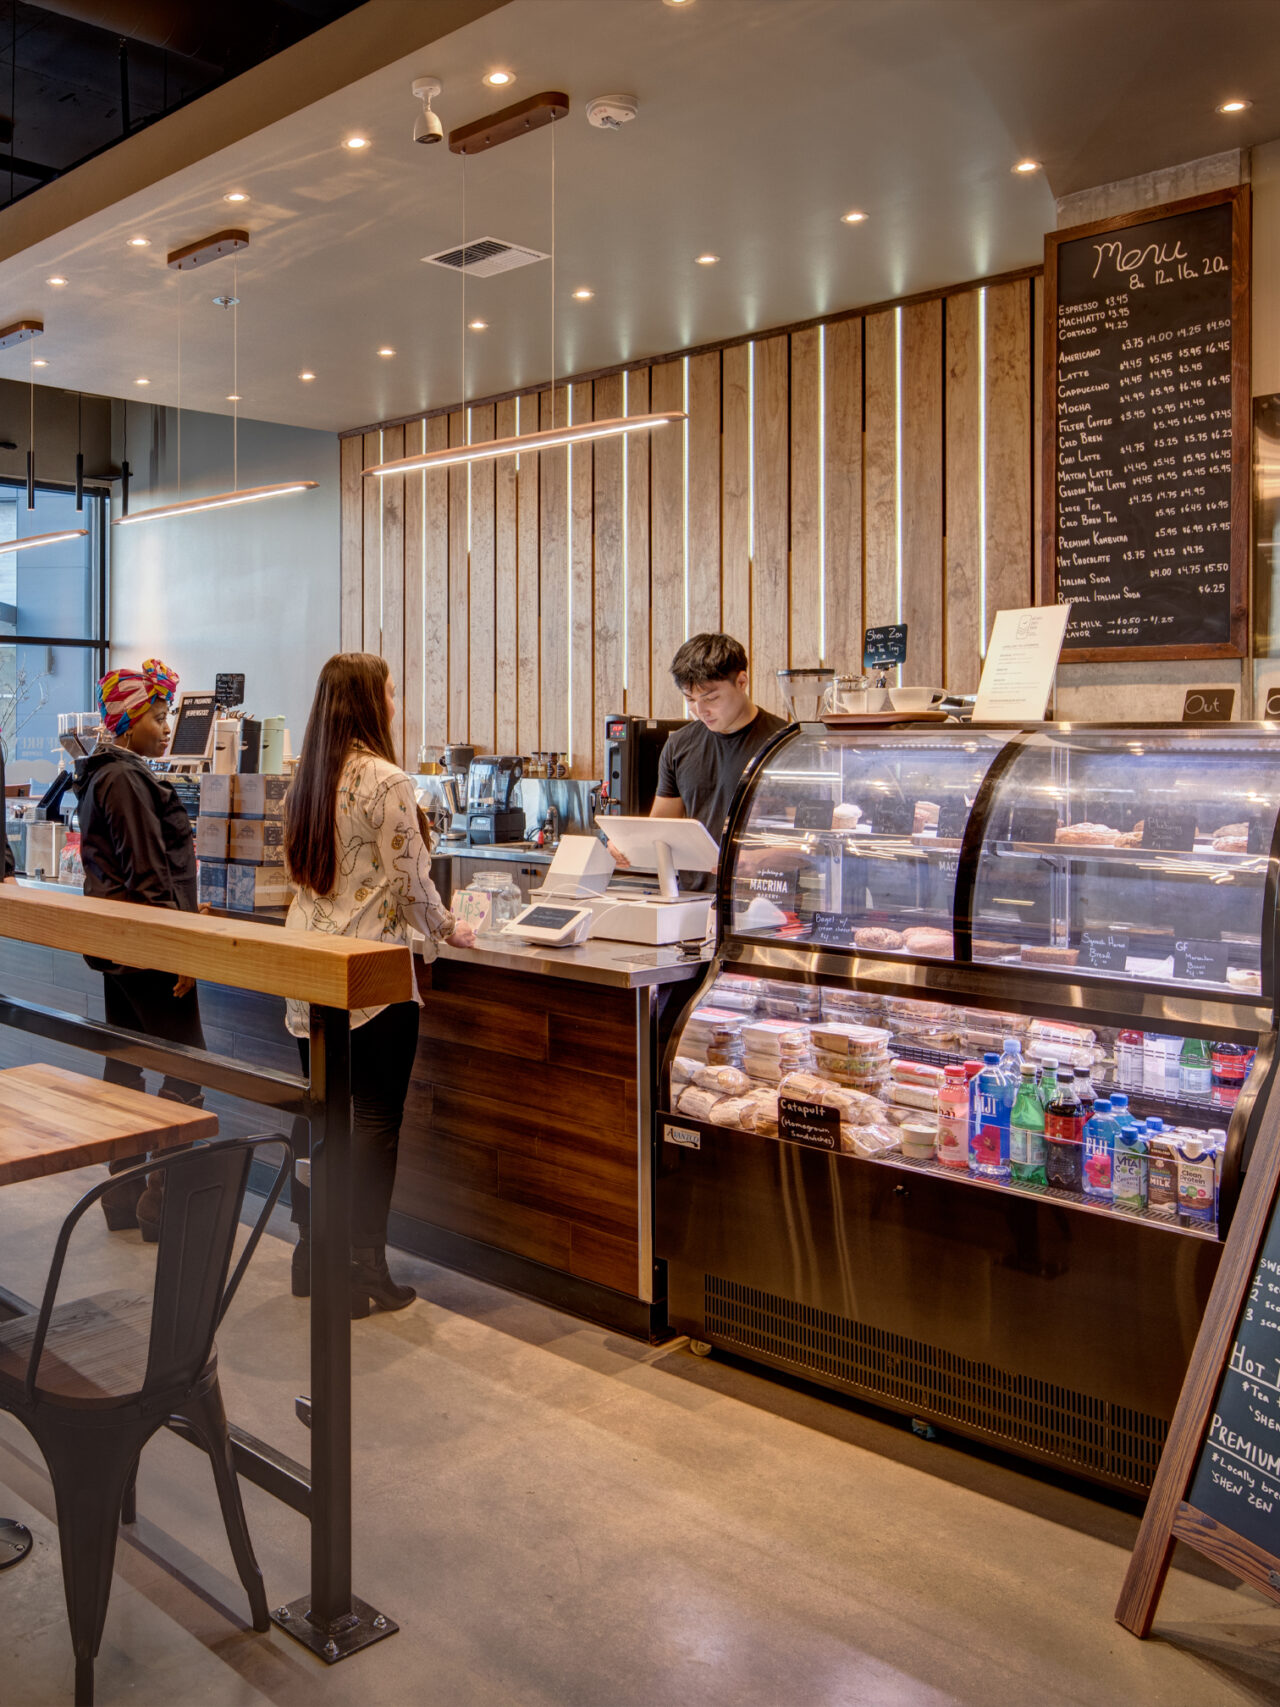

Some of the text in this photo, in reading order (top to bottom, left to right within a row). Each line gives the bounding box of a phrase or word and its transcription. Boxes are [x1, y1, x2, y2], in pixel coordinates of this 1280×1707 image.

[1093, 241, 1188, 278] Menu
[1106, 294, 1128, 306] $3.45
[1109, 308, 1130, 318] $3.95
[1105, 321, 1128, 329] $4.25
[1122, 337, 1144, 351] $3.75
[1147, 331, 1173, 344] $4.00
[1177, 325, 1202, 338] $4.25
[1207, 319, 1231, 332] $4.50
[1120, 358, 1142, 370] $4.45
[1150, 353, 1173, 364] $5.45
[1179, 347, 1201, 357] $5.95
[1206, 341, 1230, 353] $6.45
[1120, 375, 1142, 386] $4.45
[1150, 369, 1173, 379] $4.95
[1120, 392, 1145, 403] $4.95
[1151, 386, 1175, 396] $5.95
[1180, 381, 1202, 392] $6.45
[1208, 374, 1231, 386] $6.95
[1121, 411, 1146, 421] $3.45
[1152, 404, 1176, 414] $3.95
[1180, 398, 1205, 409] $4.45
[1183, 414, 1206, 424] $6.45
[1211, 410, 1231, 420] $7.45
[1120, 443, 1145, 454] $4.75
[1154, 437, 1178, 447] $5.25
[1185, 432, 1208, 442] $5.75
[1212, 429, 1232, 440] $6.25
[1124, 462, 1147, 473] $4.45
[1153, 457, 1175, 467] $5.45
[1183, 453, 1207, 463] $5.95
[1211, 450, 1231, 460] $6.45
[1133, 475, 1152, 485] $4.45
[1210, 464, 1231, 473] $5.95
[1129, 494, 1152, 505] $4.25
[1157, 491, 1177, 499] $4.75
[1181, 487, 1205, 497] $4.95
[1156, 528, 1178, 538] $5.95
[1182, 525, 1204, 534] $6.95
[1207, 522, 1231, 532] $7.95
[1123, 551, 1145, 560] $3.75
[1154, 548, 1175, 558] $4.25
[1183, 545, 1204, 555] $4.75
[1150, 569, 1171, 578] $4.00
[1178, 566, 1201, 575] $4.75
[1205, 564, 1228, 573] $5.50
[1199, 584, 1225, 595] $6.25
[1185, 695, 1220, 714] Out
[750, 880, 788, 894] MACRINA
[458, 892, 480, 921] Tips
[1175, 941, 1188, 952] GF
[781, 1099, 826, 1118] Catapult
[1086, 1137, 1108, 1156] FIJI
[1117, 1156, 1138, 1168] VITA
[1150, 1177, 1170, 1188] MILK
[1180, 1175, 1206, 1185] Protein
[1181, 1170, 1202, 1178] Clean
[1250, 1289, 1259, 1302] 2
[1246, 1308, 1254, 1321] 3
[1231, 1341, 1266, 1378] HOT
[1220, 1457, 1255, 1488] Locally
[1212, 1473, 1272, 1513] SHEN ZEN
